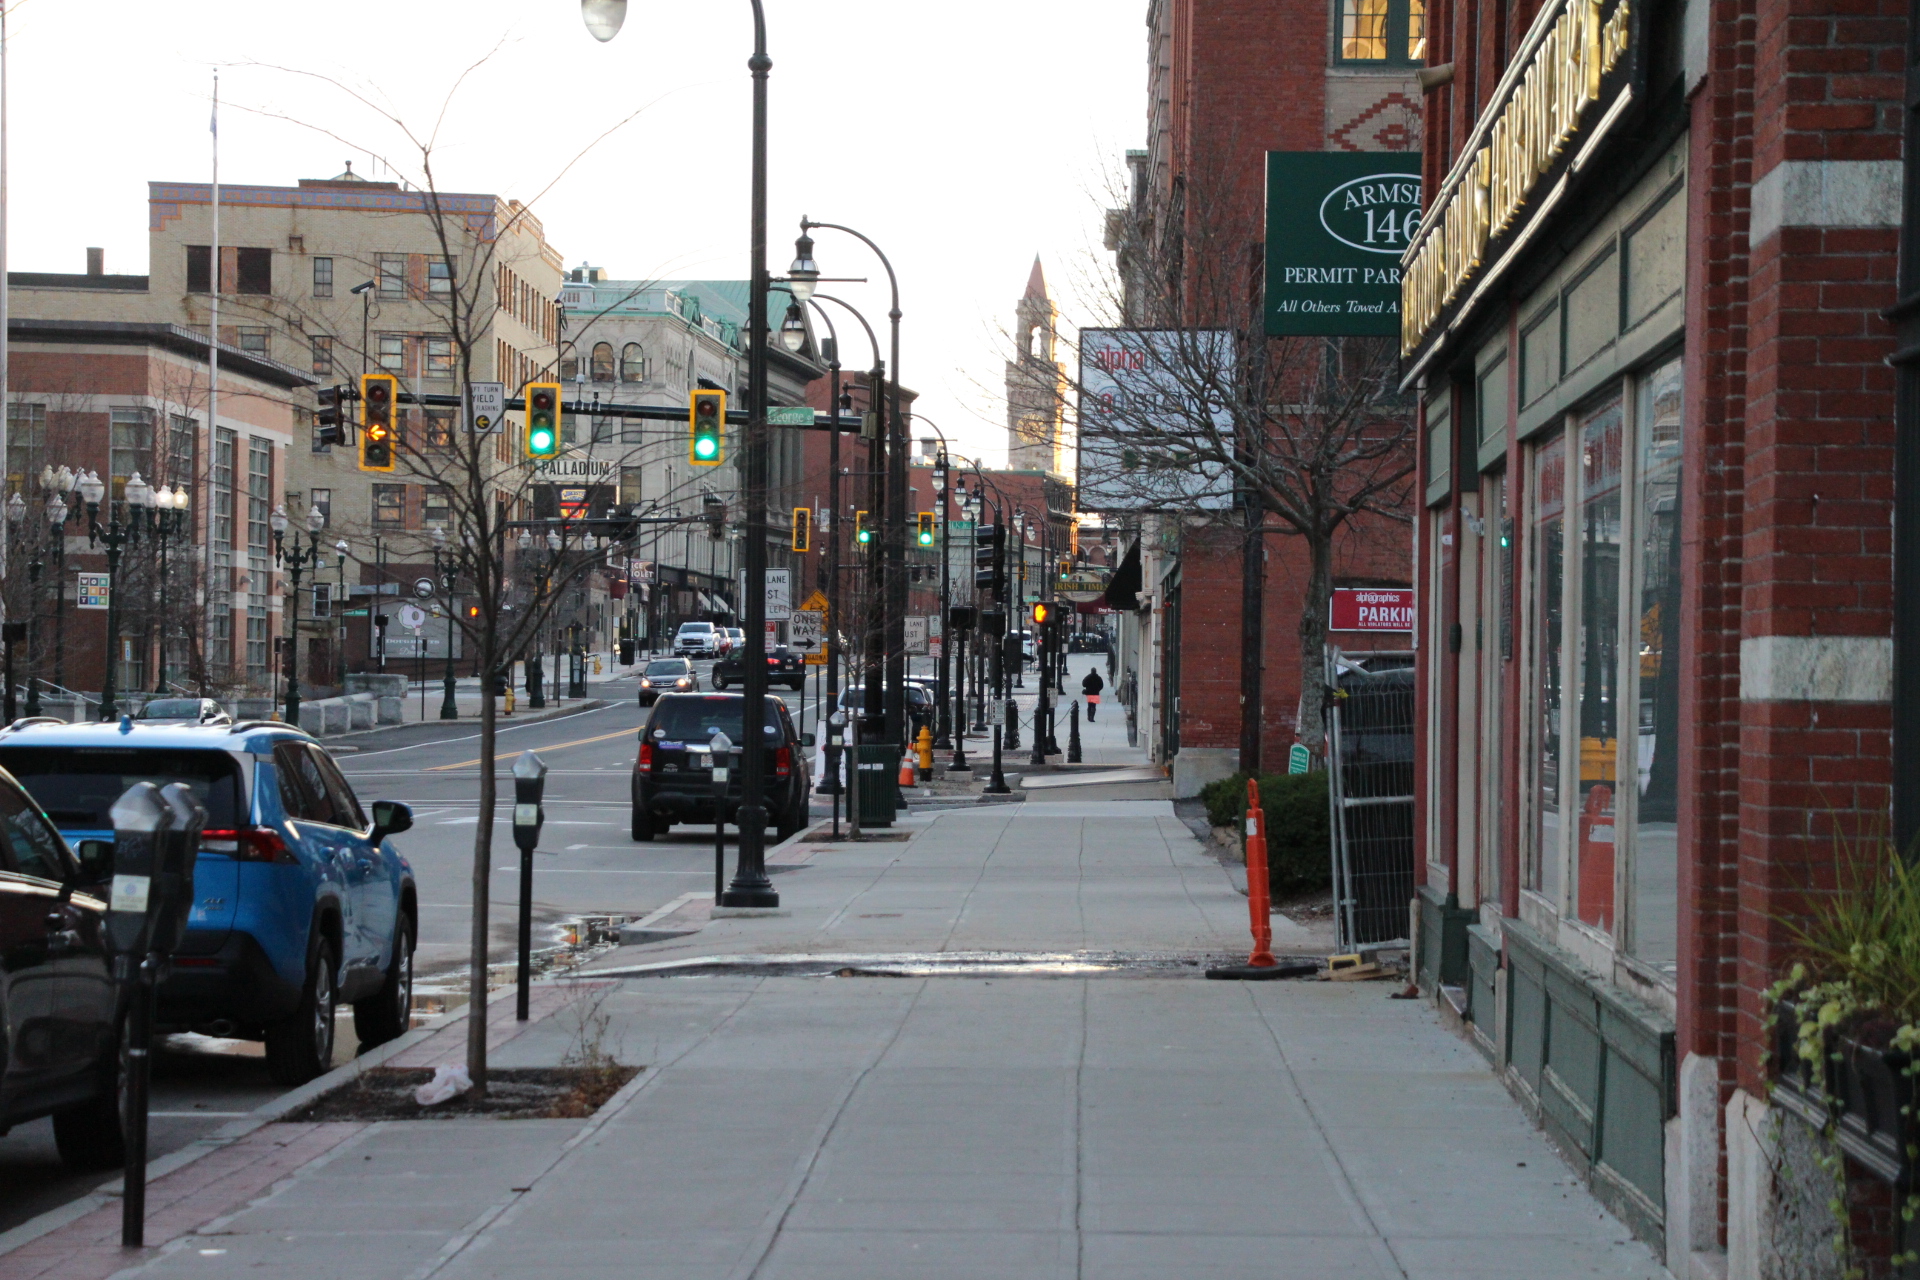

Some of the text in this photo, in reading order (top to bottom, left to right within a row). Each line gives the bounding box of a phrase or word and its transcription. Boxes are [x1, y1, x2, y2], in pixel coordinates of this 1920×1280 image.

[1363, 208, 1422, 244] 146
[1284, 267, 1357, 284] PERMIT
[1277, 300, 1297, 313] All
[1301, 299, 1341, 313] Others
[1346, 300, 1383, 313] Towed
[471, 394, 495, 403] YIELD
[768, 408, 804, 424] George
[542, 461, 610, 476] PALLADIUM
[766, 575, 786, 584] LANE
[1055, 582, 1109, 591] IRISH TIMES
[1355, 591, 1400, 604] alphagraphics
[769, 605, 787, 614] LEFT
[1358, 606, 1413, 622] PARKIN
[794, 614, 816, 624] ONE
[792, 625, 817, 636] WAY
[904, 630, 918, 638] UST
